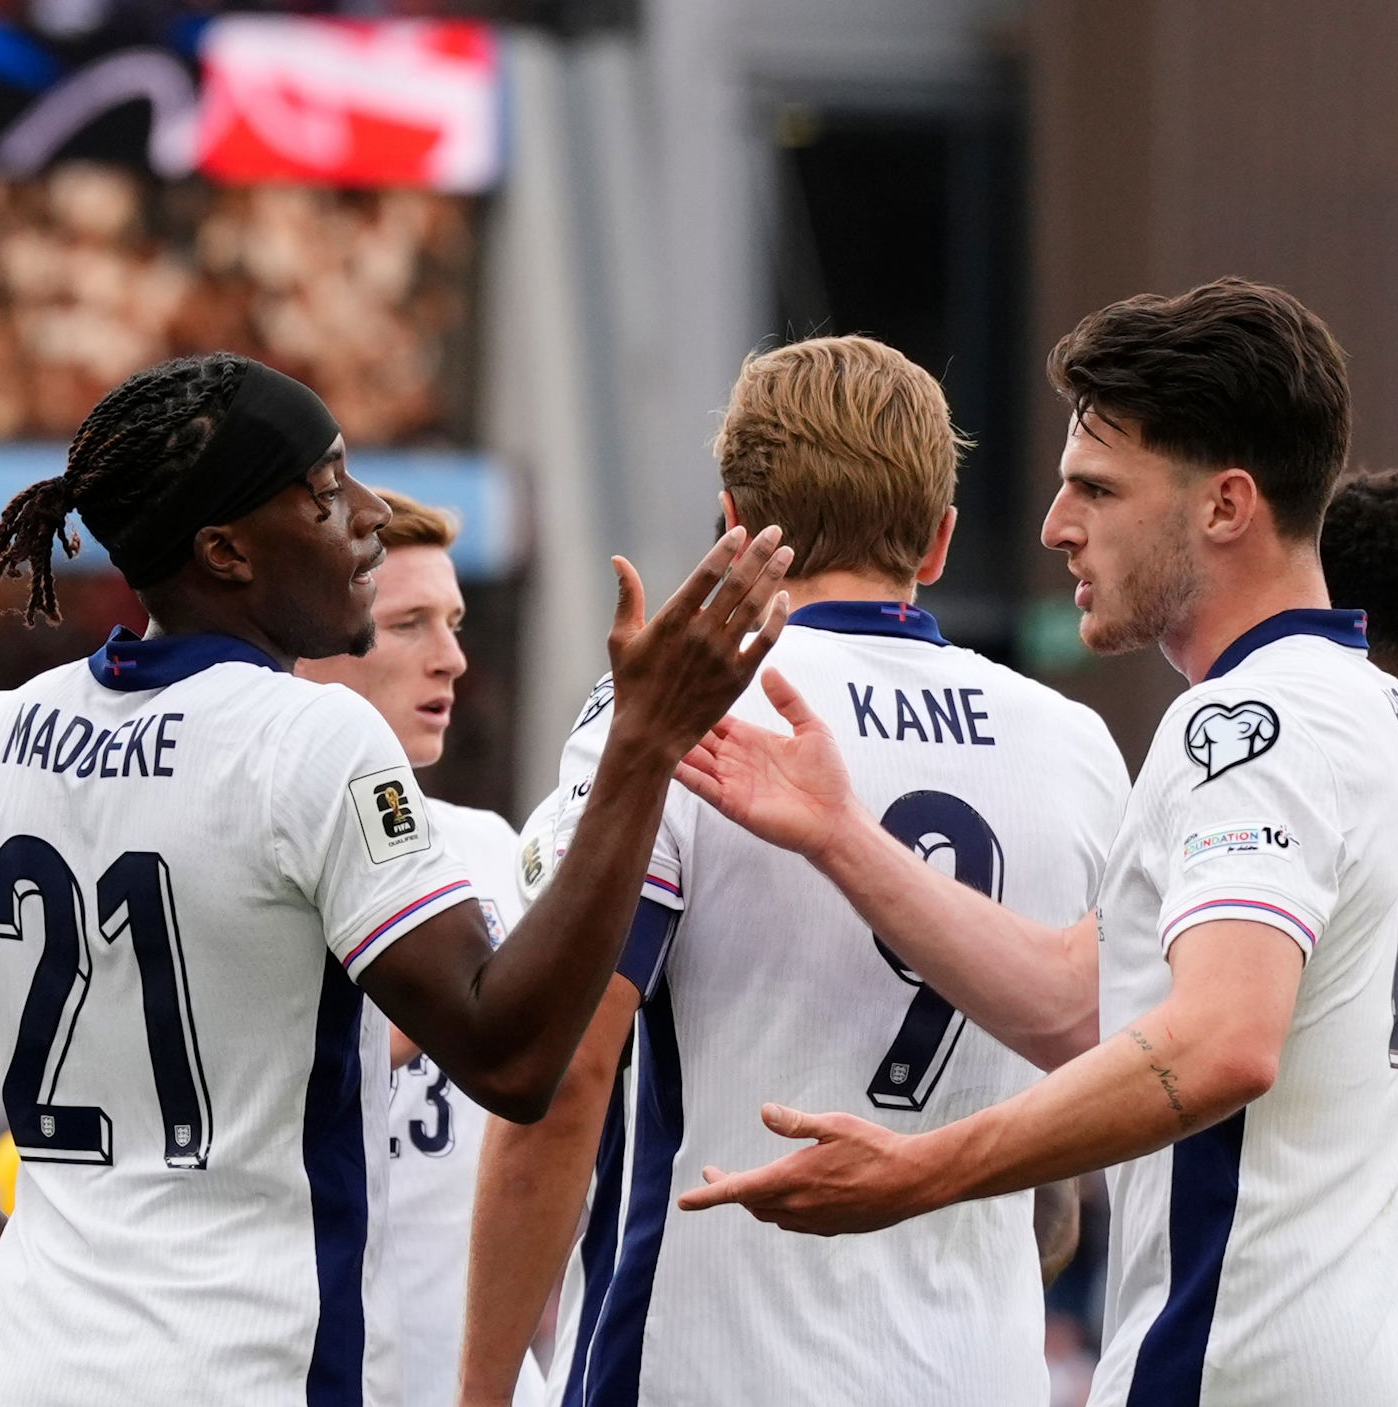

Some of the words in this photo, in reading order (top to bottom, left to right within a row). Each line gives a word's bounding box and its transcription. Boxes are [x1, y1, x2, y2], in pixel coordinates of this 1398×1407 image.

[847, 682, 995, 745] KANE
[393, 822, 411, 833] FIFA
[867, 788, 1005, 1112] 9
[390, 1052, 456, 1158] 3
